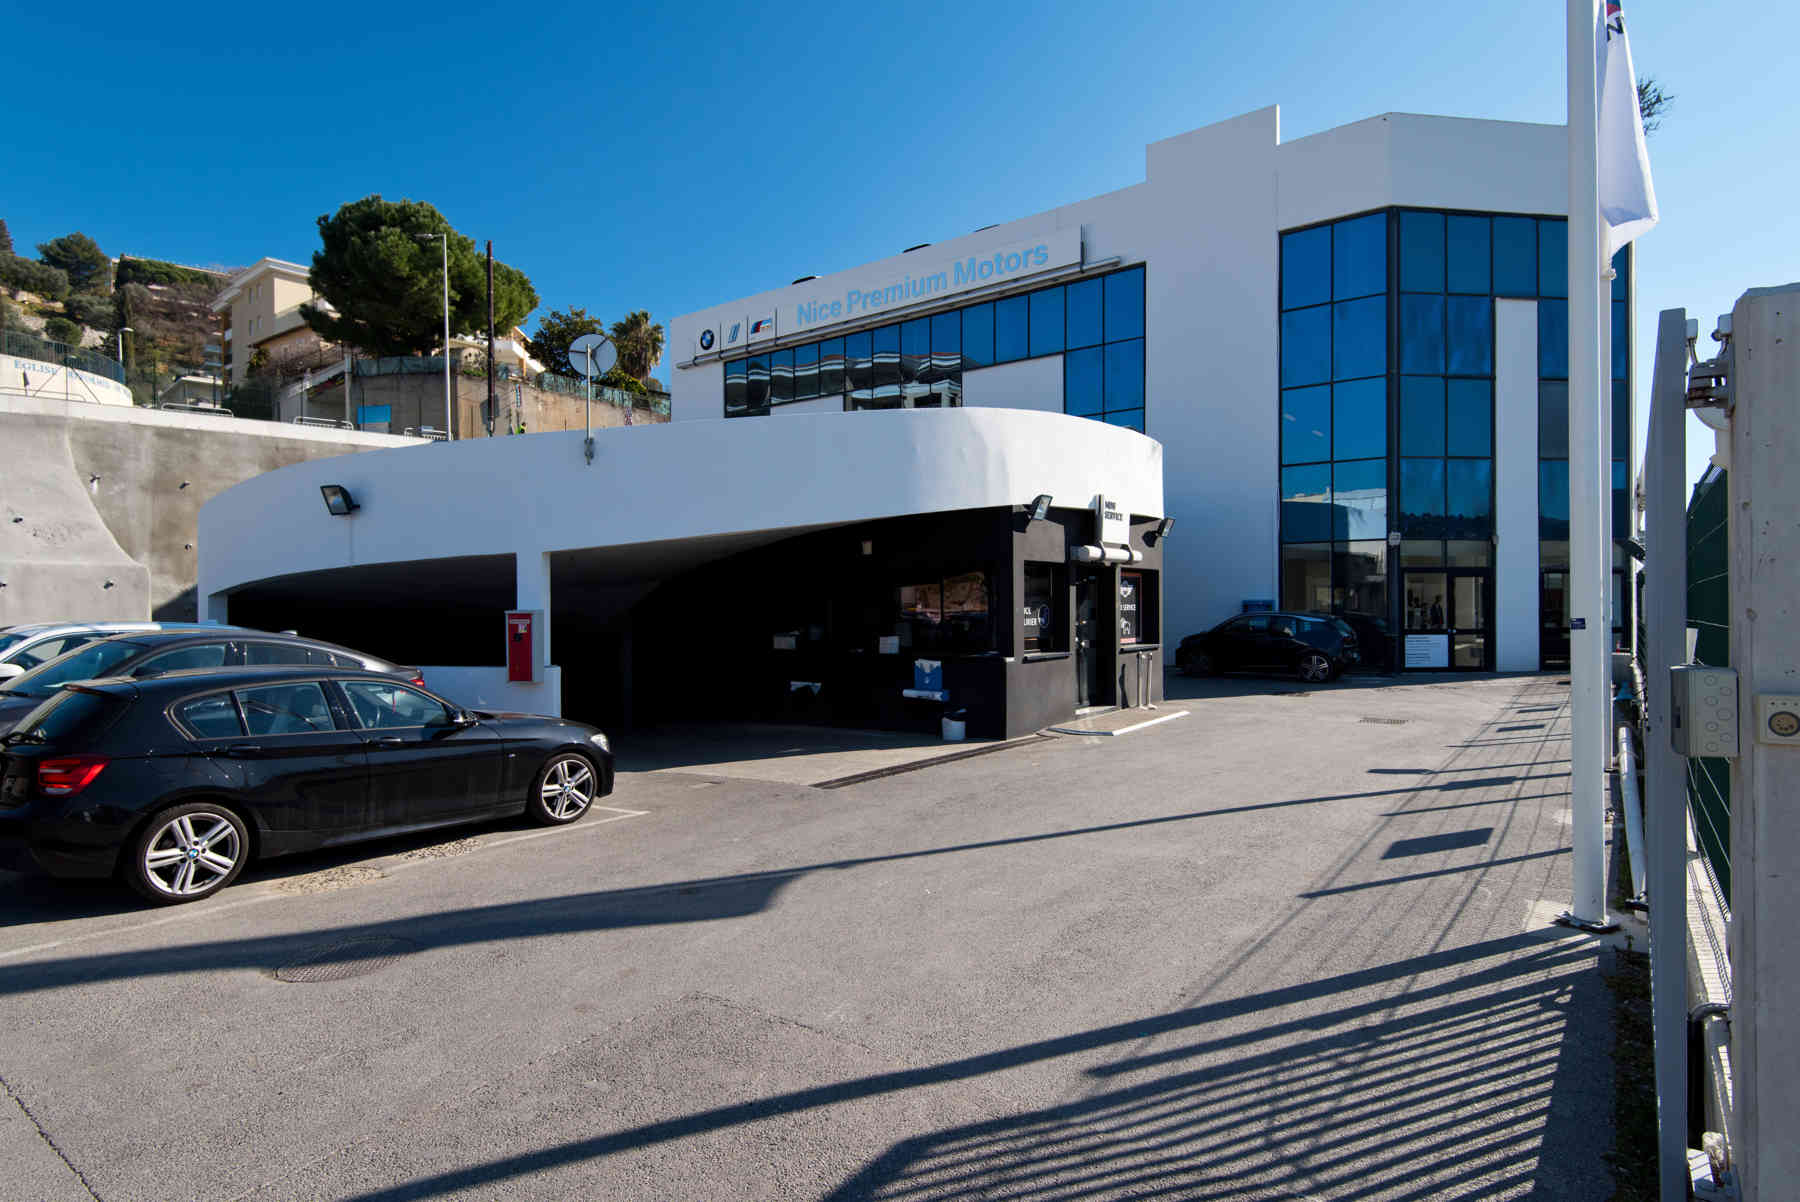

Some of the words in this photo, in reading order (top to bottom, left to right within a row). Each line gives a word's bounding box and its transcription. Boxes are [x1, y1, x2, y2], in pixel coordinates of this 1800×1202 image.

[797, 300, 842, 326] Nice
[847, 271, 947, 313] Premium
[953, 244, 1049, 286] Motors
